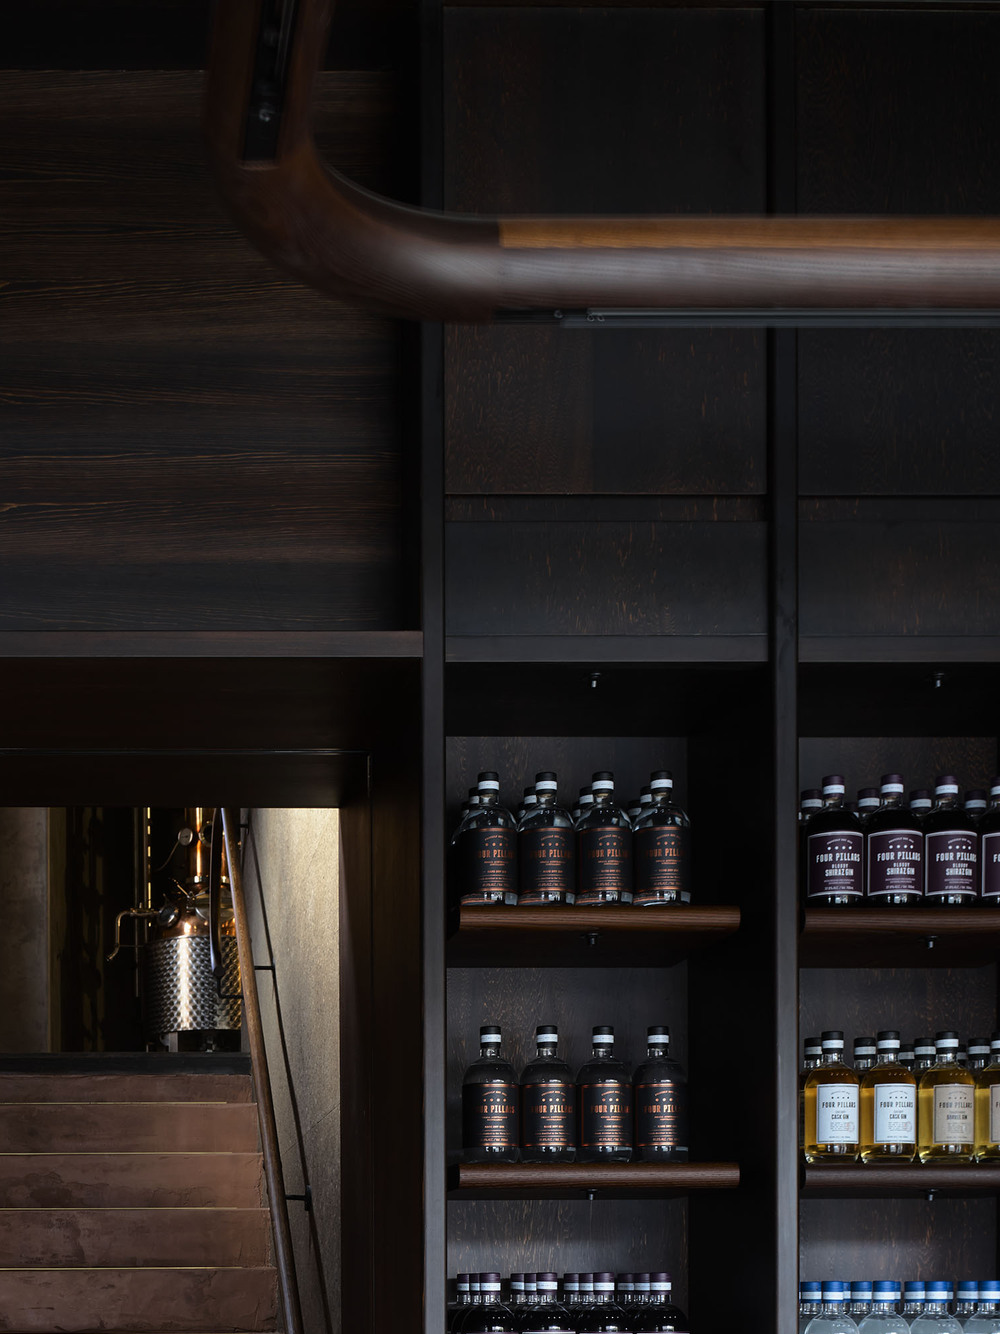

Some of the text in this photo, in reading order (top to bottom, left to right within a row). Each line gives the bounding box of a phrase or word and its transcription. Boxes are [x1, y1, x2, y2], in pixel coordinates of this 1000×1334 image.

[493, 849, 516, 858] PILLA
[548, 849, 573, 858] PILLA
[607, 848, 632, 858] PILLA
[665, 848, 686, 857] PILL
[877, 851, 921, 862] FOUR PILLARS
[816, 852, 860, 863] FOUR PILLARS
[936, 852, 977, 863] FOUR PILLARS
[825, 869, 845, 877] SHIRAZ
[946, 868, 964, 876] SHIRAZ
[473, 1105, 488, 1113] UR
[549, 1105, 573, 1113] PILLA
[609, 1105, 630, 1113] PILLA
[663, 1105, 685, 1113] PILL
